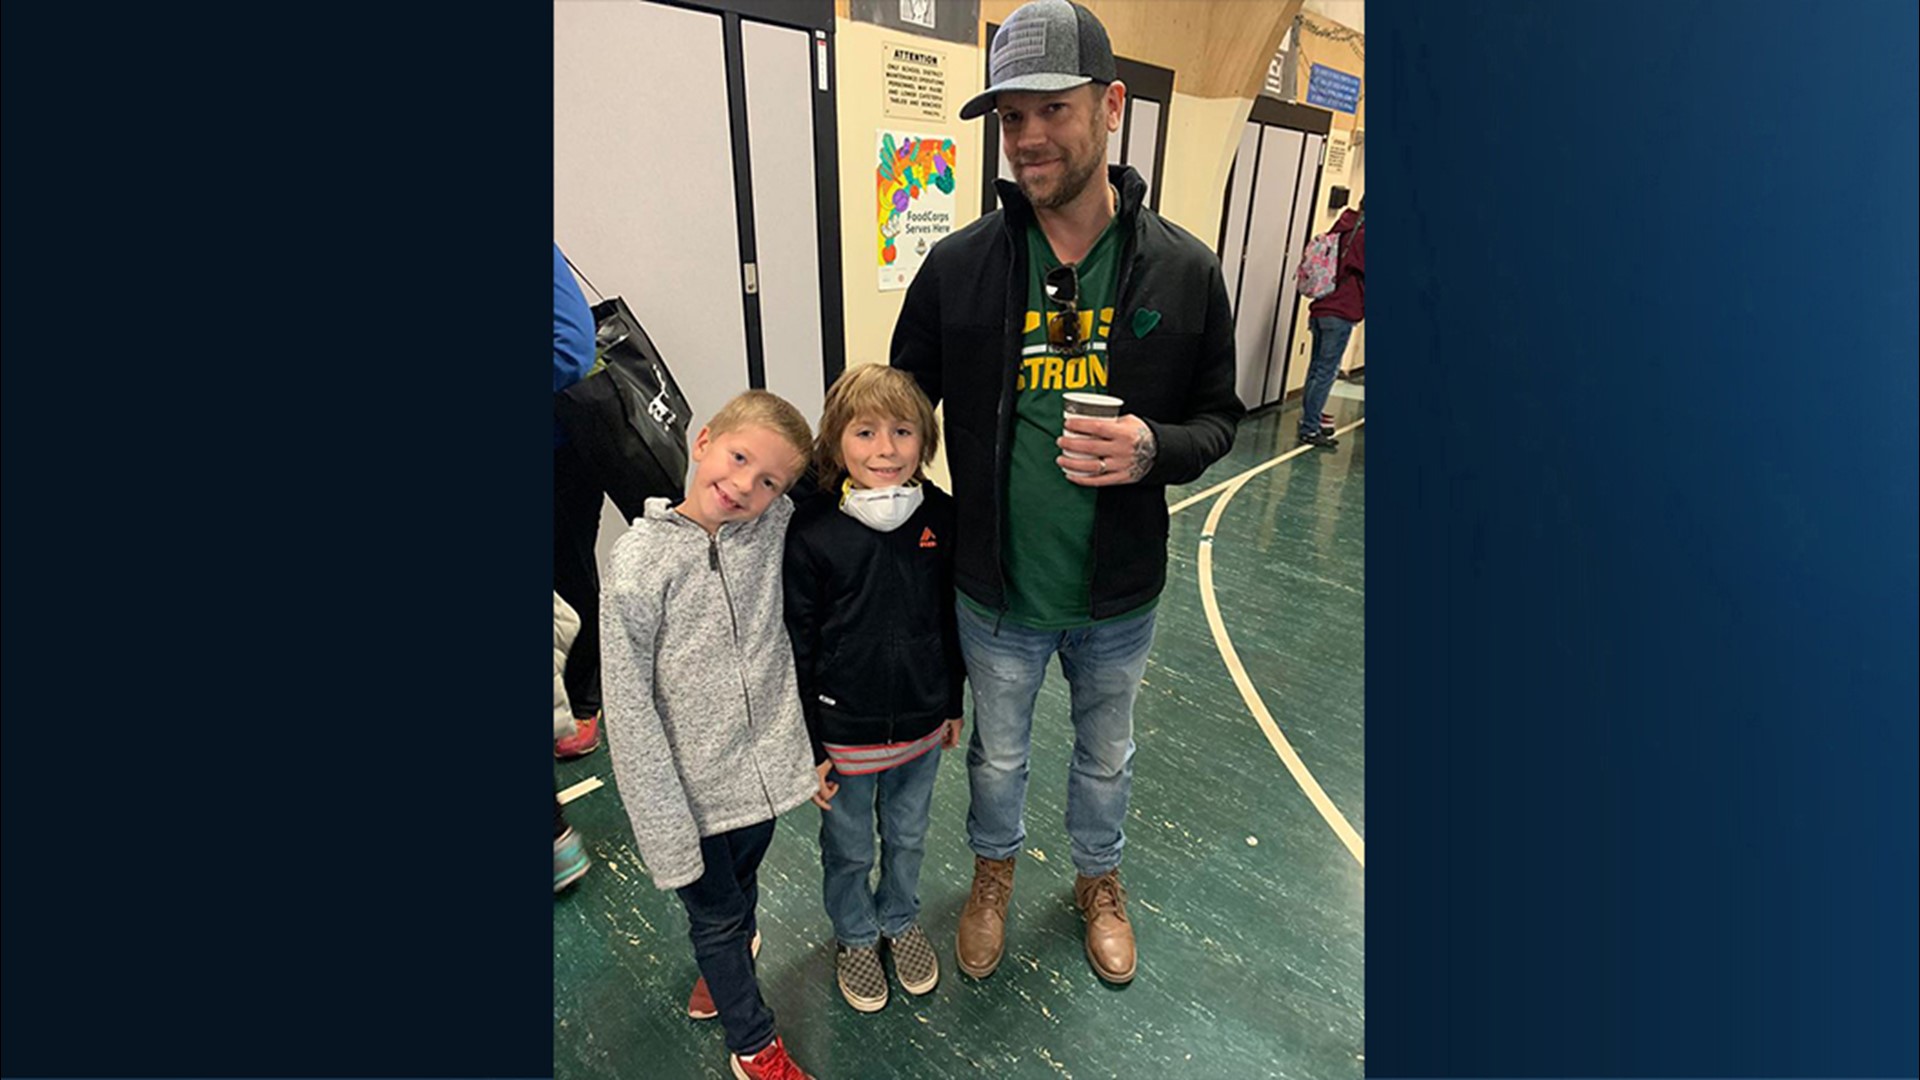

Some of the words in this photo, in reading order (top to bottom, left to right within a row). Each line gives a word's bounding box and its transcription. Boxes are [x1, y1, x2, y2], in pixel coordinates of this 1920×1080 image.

[894, 49, 938, 64] ATTENTION
[887, 63, 899, 71] ONLY
[902, 66, 920, 74] SCHOOL
[886, 72, 917, 82] MAINTENANCE
[888, 80, 916, 89] PERSONNEL
[890, 97, 908, 105] TABLES
[907, 210, 949, 222] FoodCorps
[905, 223, 931, 234] Serves
[932, 224, 950, 233] Here
